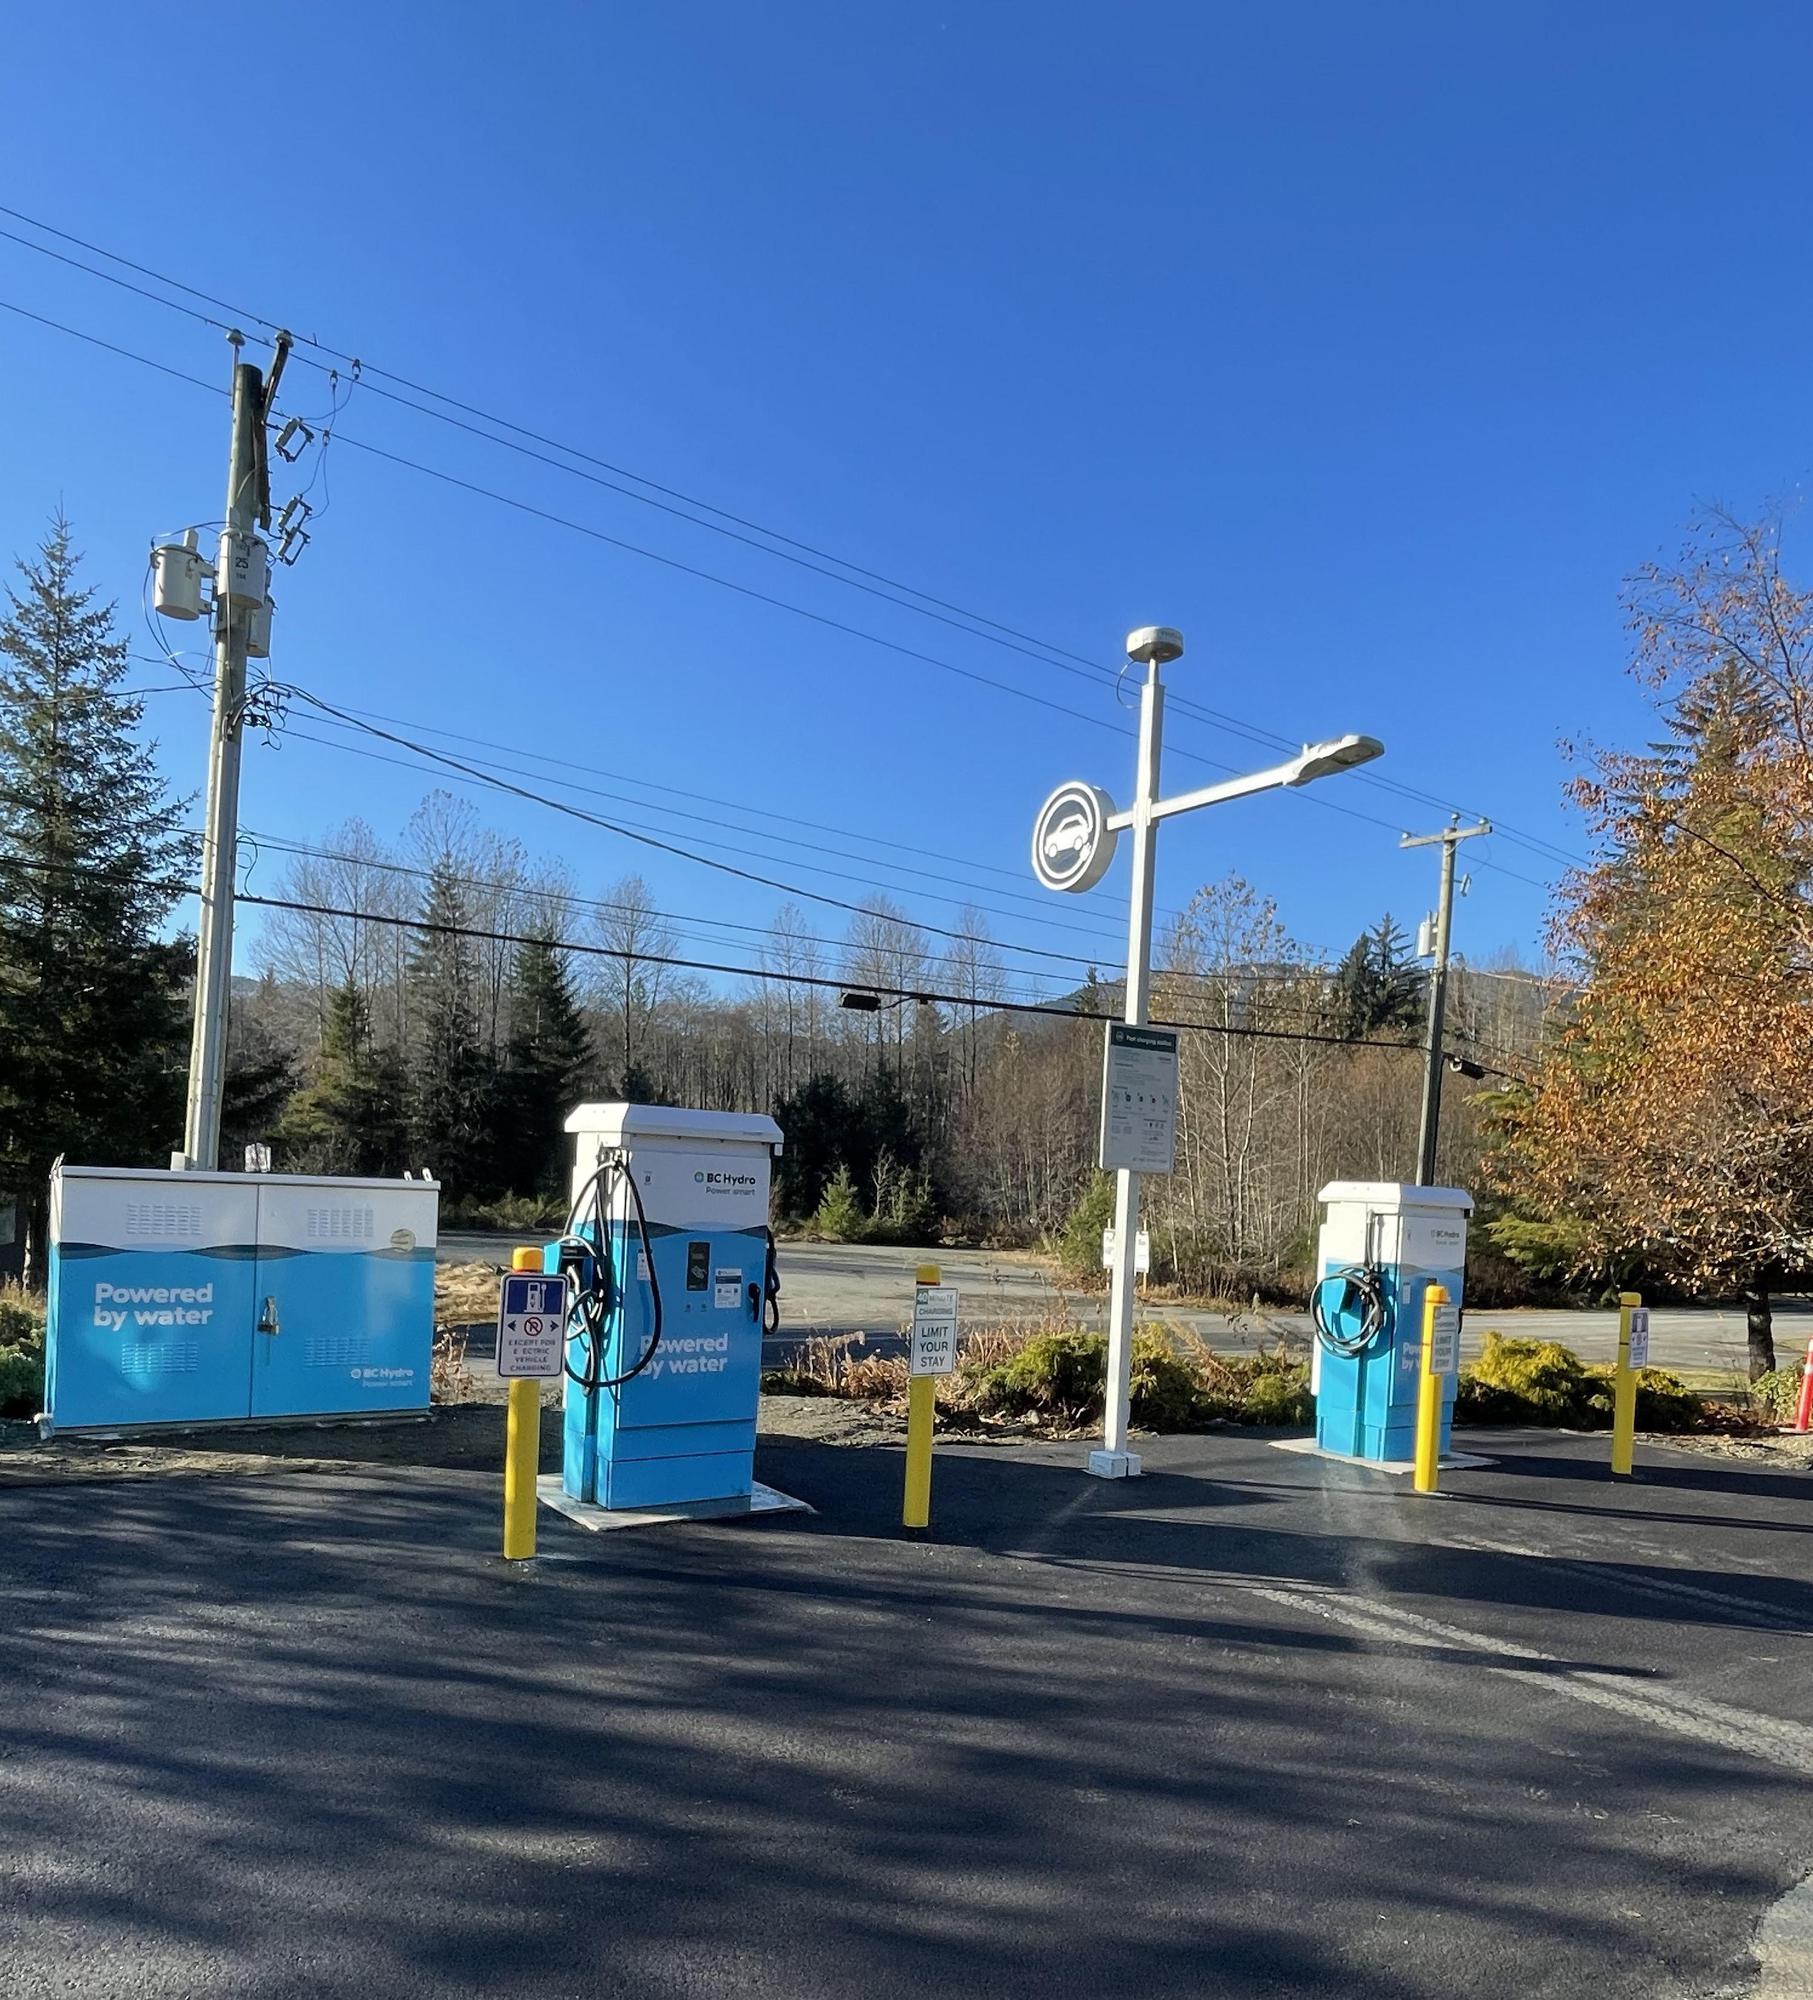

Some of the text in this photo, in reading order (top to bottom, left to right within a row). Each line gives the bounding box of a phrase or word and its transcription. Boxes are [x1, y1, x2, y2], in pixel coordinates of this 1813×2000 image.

[235, 557, 249, 569] 25
[706, 1173, 756, 1187] BC Hydro
[705, 1186, 731, 1195] Power
[95, 1282, 214, 1304] Powered
[93, 1306, 214, 1332] by water
[921, 1327, 948, 1337] LIMIT
[640, 1333, 729, 1355] Powered
[920, 1341, 948, 1352] YOUR
[513, 1347, 550, 1355] EECTRIC
[668, 1356, 728, 1374] water
[920, 1356, 945, 1367] STAY
[380, 1367, 415, 1380] Hydro
[510, 1364, 552, 1372] CHARGING
